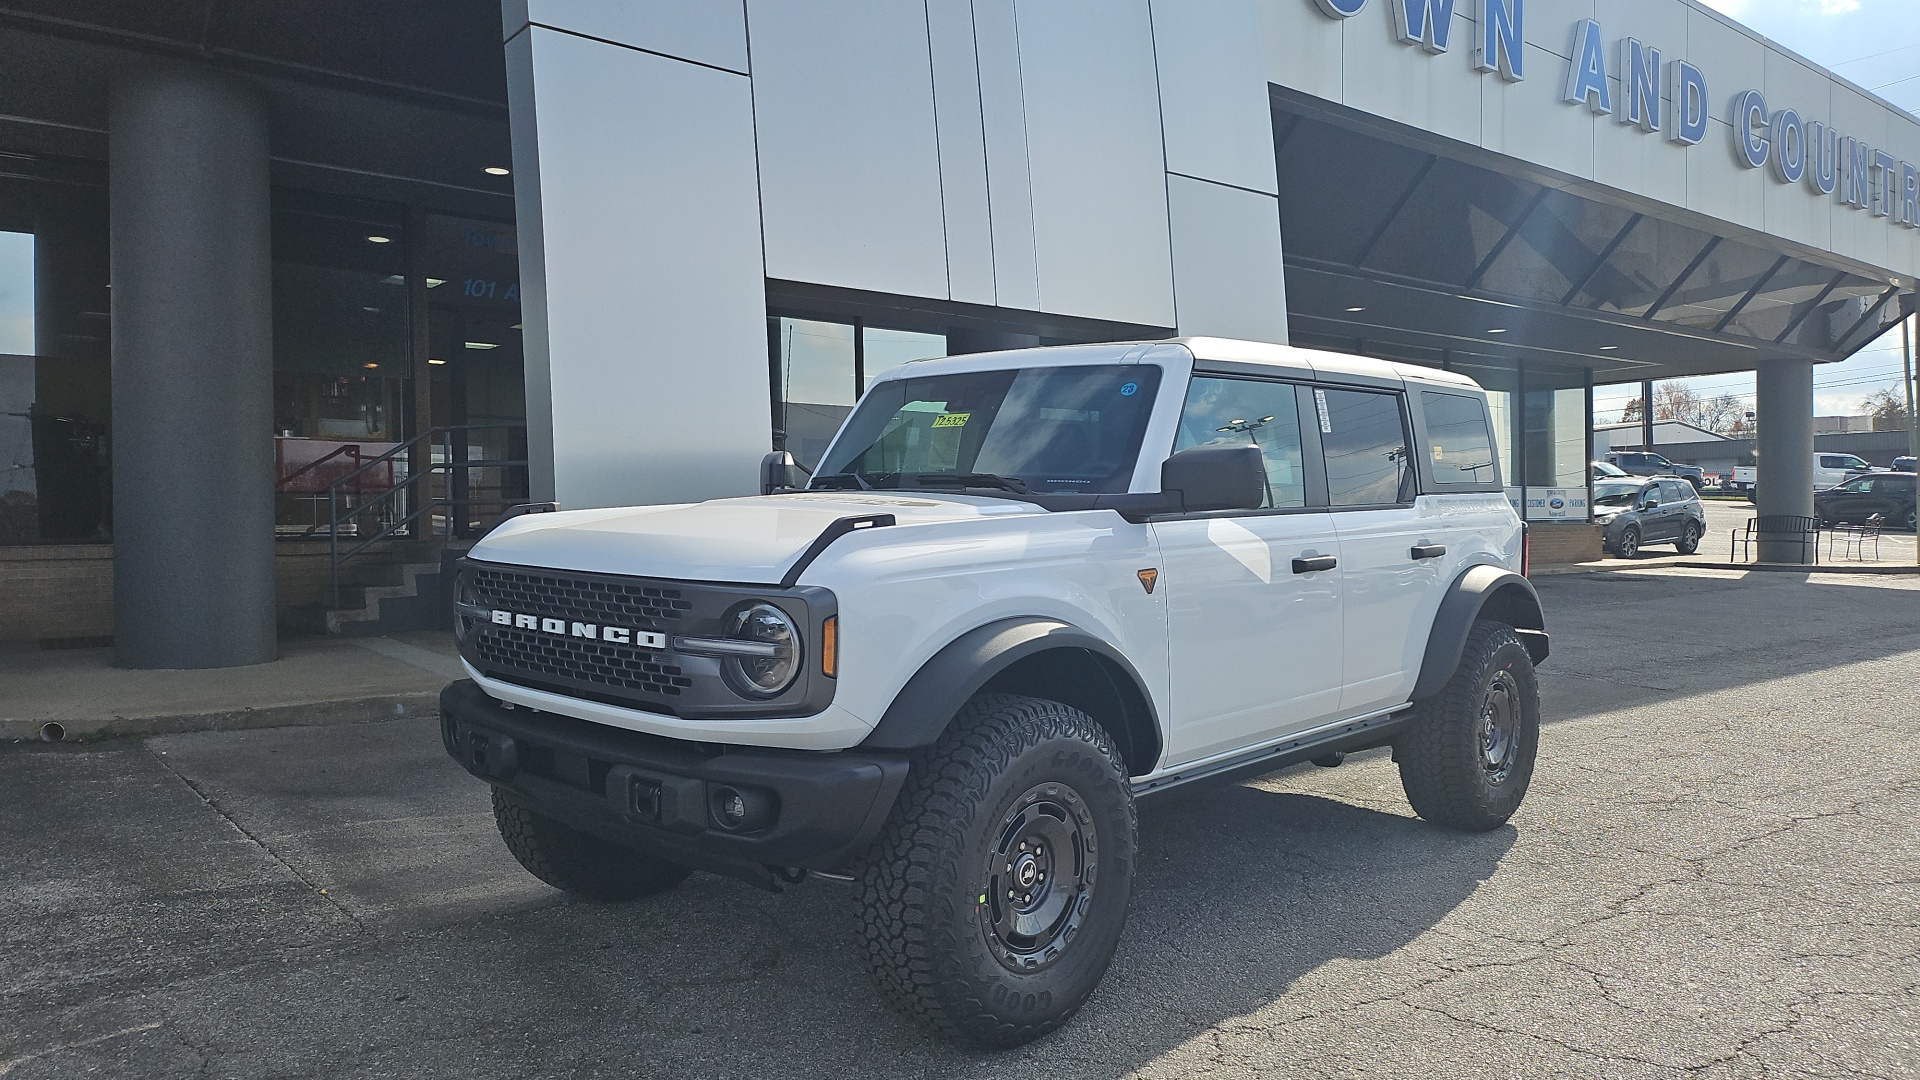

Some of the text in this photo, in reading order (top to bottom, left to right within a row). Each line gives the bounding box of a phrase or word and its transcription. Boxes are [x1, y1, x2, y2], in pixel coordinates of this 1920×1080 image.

[1564, 18, 1709, 146] AND
[463, 278, 497, 298] 101
[1569, 498, 1586, 508] PARKING
[491, 609, 666, 649] BRONCO
